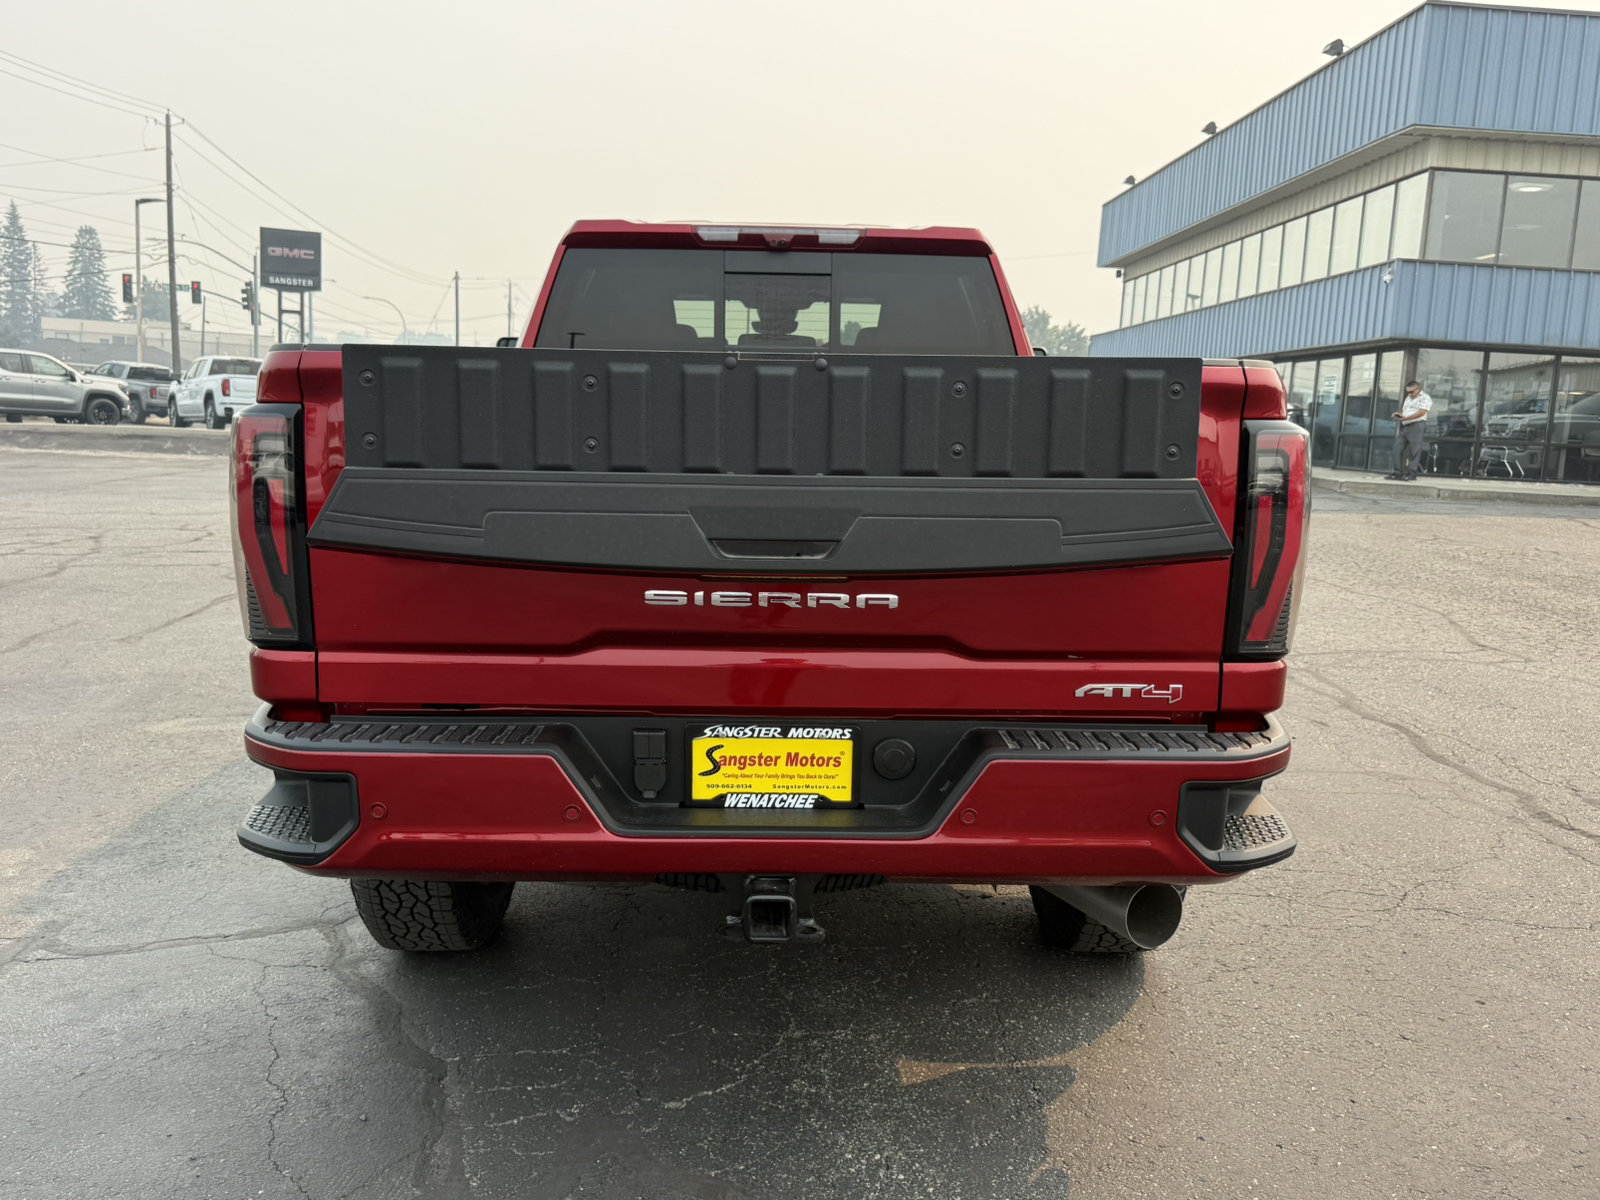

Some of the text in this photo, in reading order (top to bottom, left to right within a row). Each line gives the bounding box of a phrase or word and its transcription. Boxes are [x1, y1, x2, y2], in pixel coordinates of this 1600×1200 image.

[267, 247, 315, 259] GMC
[268, 276, 314, 287] SANGSTER
[644, 589, 899, 609] SIERRA
[1074, 683, 1183, 704] AT4
[703, 724, 853, 739] SANGSTER MOTORS
[698, 744, 842, 776] Sangster Motors
[724, 793, 818, 809] WENATCHEE
